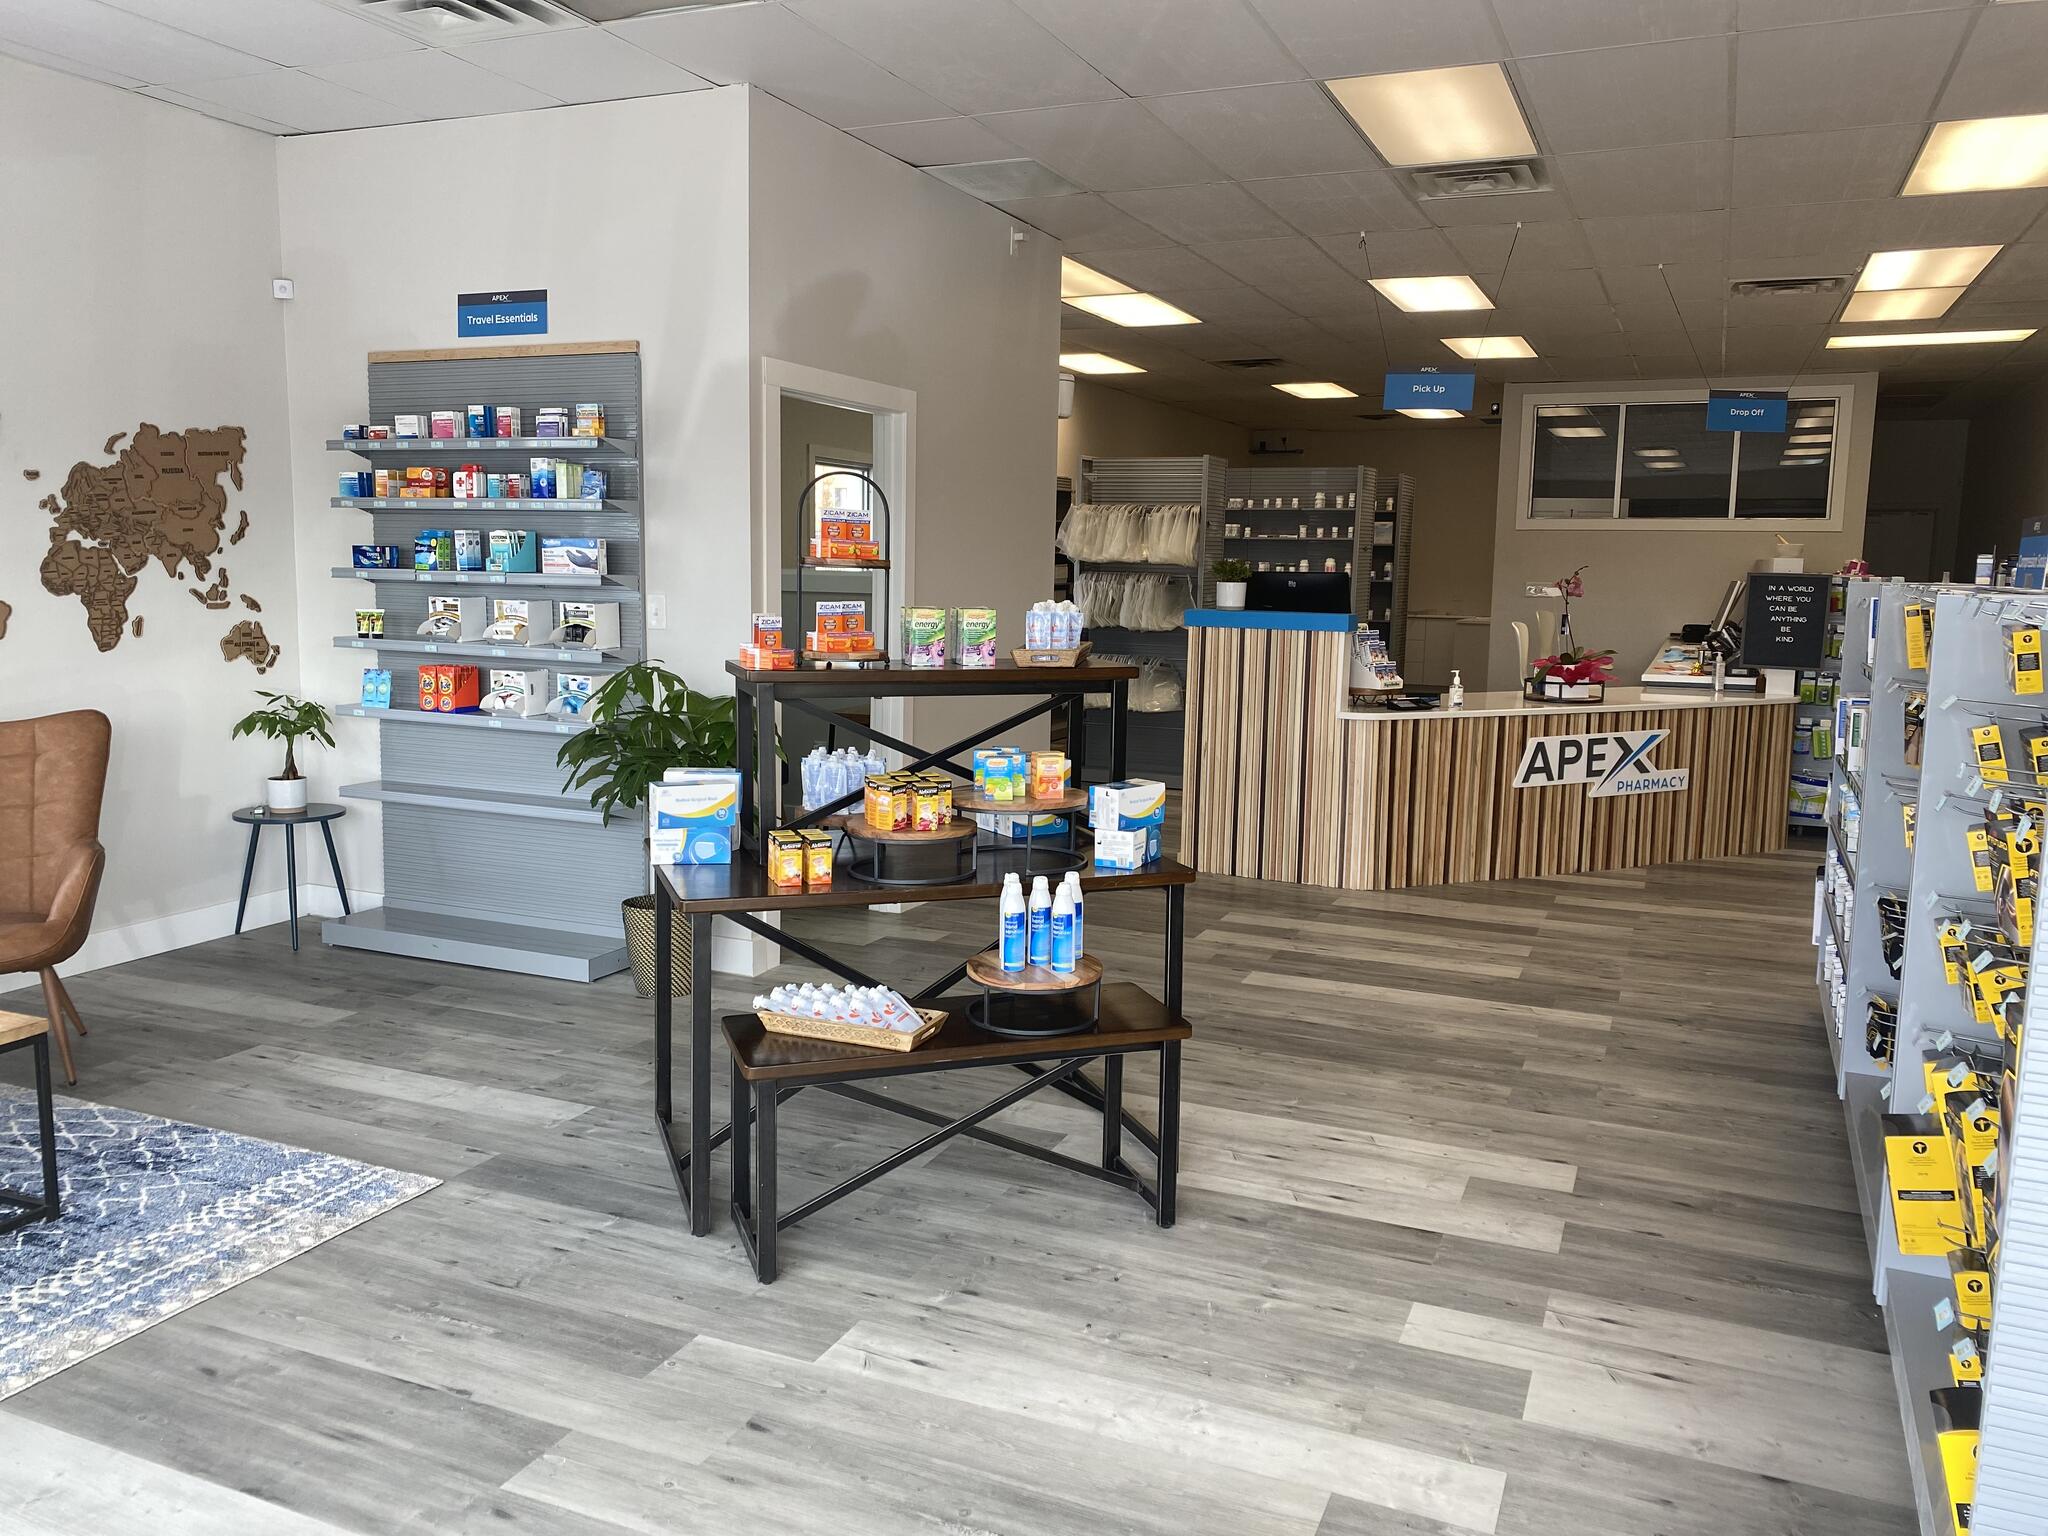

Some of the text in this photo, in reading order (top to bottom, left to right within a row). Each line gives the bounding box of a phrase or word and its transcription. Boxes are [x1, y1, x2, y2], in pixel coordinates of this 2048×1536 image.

[467, 313, 538, 325] Travel Essentials
[1433, 385, 1446, 394] Up
[1730, 408, 1750, 416] Drop
[1522, 734, 1662, 791] APEX
[1616, 776, 1686, 792] PHARMACY
